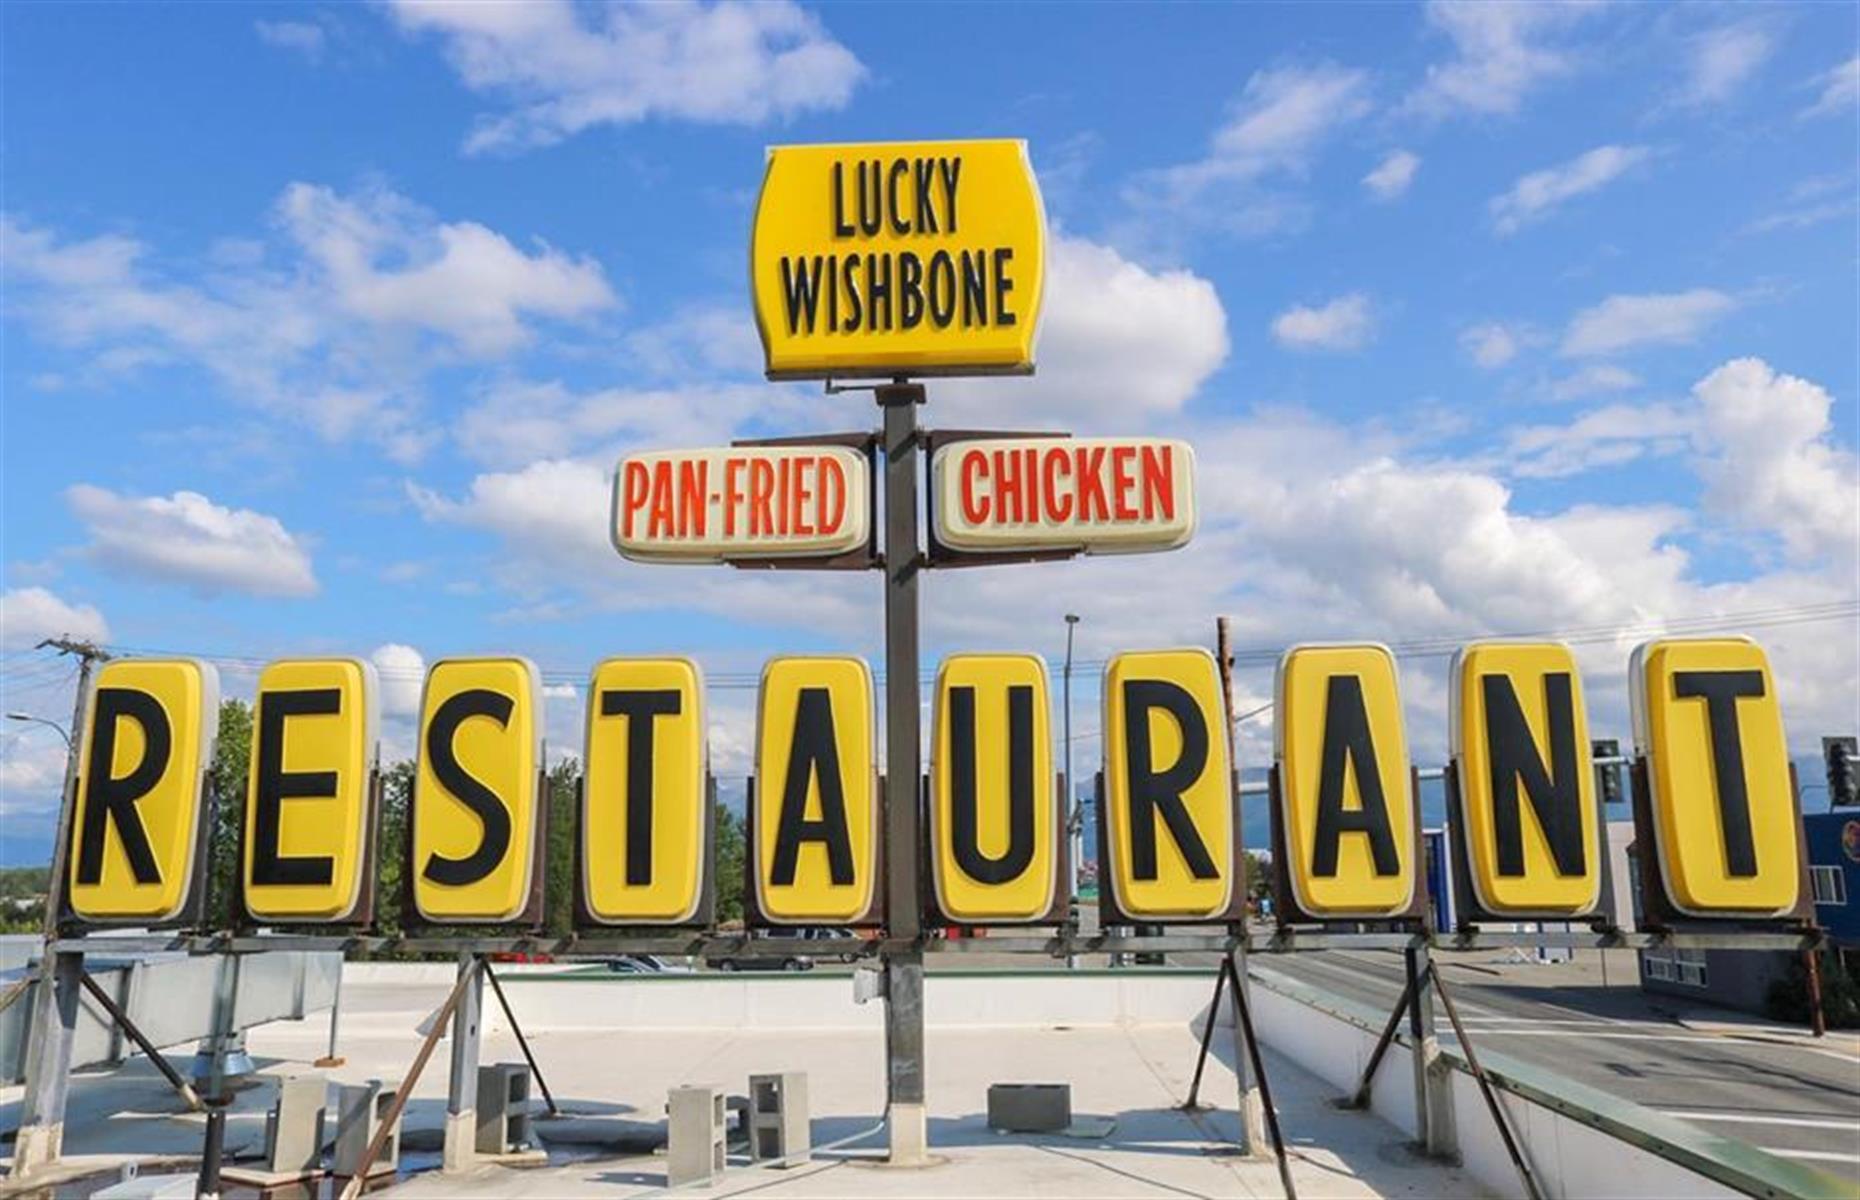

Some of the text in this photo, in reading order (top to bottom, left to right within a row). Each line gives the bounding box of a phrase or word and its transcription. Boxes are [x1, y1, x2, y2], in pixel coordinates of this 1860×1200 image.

[834, 157, 962, 238] LUCKY
[781, 248, 1016, 335] WISHBONE
[623, 456, 846, 539] PAN-FRIED
[960, 445, 1175, 525] CHICKEN
[77, 669, 1767, 886] RESTAURANT
